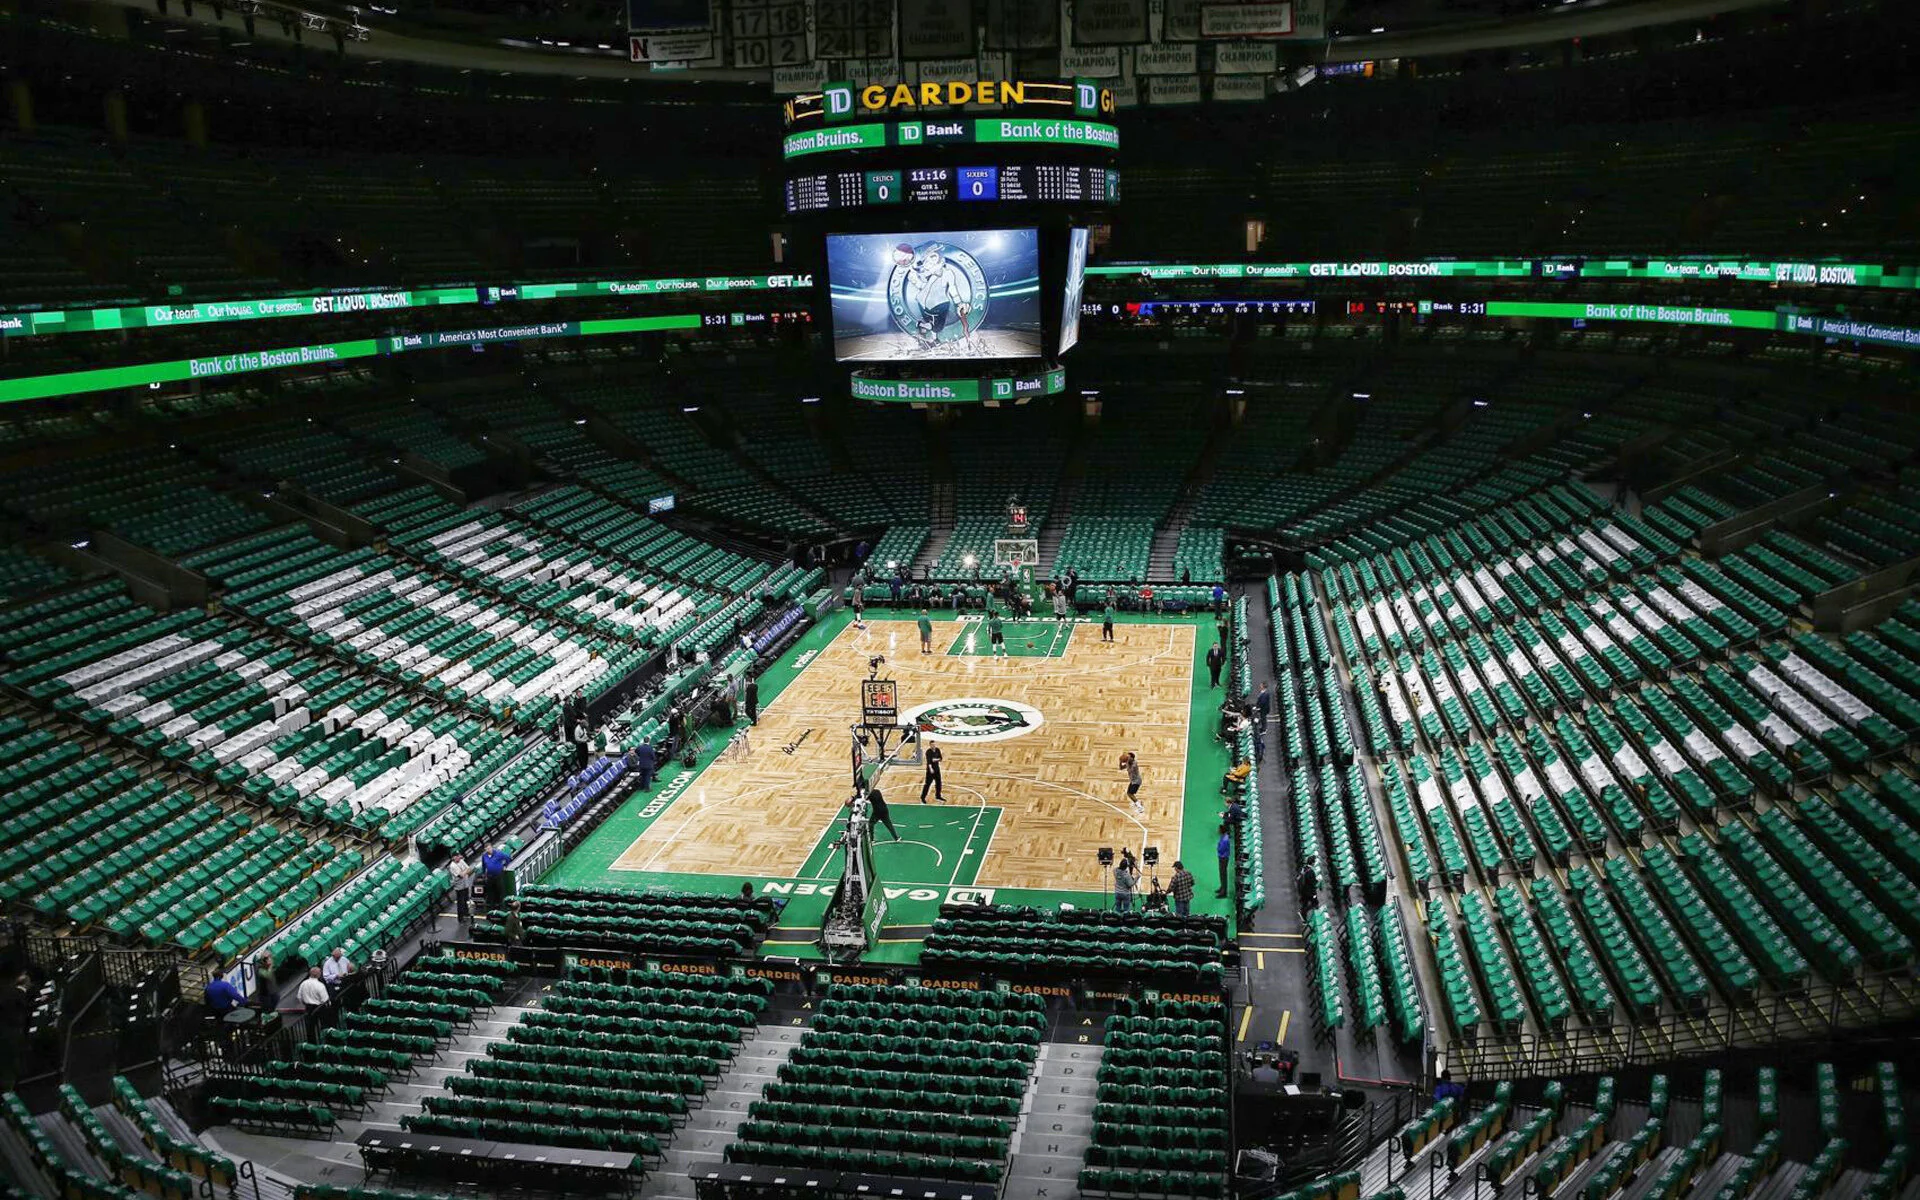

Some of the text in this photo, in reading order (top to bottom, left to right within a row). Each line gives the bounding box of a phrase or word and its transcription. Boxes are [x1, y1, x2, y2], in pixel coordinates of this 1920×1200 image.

[736, 11, 763, 34] 17
[776, 10, 800, 33] 18
[632, 38, 648, 59] N
[737, 43, 765, 65] 10
[780, 39, 796, 62] 2
[1065, 56, 1116, 67] CHAMPIONS
[1141, 53, 1192, 65] CHAMPIONS
[1220, 51, 1273, 62] CHAMPIONS
[826, 81, 1024, 113] TD GARDEN
[1077, 84, 1096, 109] TD
[901, 124, 964, 140] TD Bank
[1000, 122, 1042, 138] Bank
[1045, 122, 1060, 138] of
[1063, 124, 1082, 139] the
[816, 130, 863, 148] Bruins.
[912, 170, 947, 181] 11:16
[878, 185, 888, 200] 0
[972, 180, 984, 196] 0
[1159, 267, 1186, 275] team.
[1211, 266, 1241, 275] house.
[1310, 264, 1337, 276] GET
[1389, 264, 1441, 276] BOSTON.
[1665, 264, 1678, 273] Our
[1680, 264, 1700, 274] team.
[1705, 264, 1718, 275] Our
[1776, 264, 1790, 281] GET
[610, 276, 793, 292] Our team. Our house. Our season. GET
[892, 252, 986, 327] BOSTON CELTICS
[501, 288, 517, 296] Bank
[155, 309, 172, 321] Our
[176, 308, 200, 320] team.
[208, 304, 224, 317] Our
[261, 303, 274, 313] Our
[313, 299, 334, 313] GET
[371, 293, 408, 307] BOSTON.
[1112, 305, 1119, 314] 0
[1460, 303, 1484, 313] 5:31
[705, 315, 726, 325] 5:31
[1586, 306, 1732, 324] Bank of the Boston Bruins.
[404, 335, 422, 346] Bank
[439, 330, 476, 343] America's
[478, 328, 497, 340] Most
[499, 325, 539, 339] Convenient
[1798, 317, 1813, 328] Bank
[1822, 320, 1850, 334] America's
[1851, 323, 1866, 335] Most
[1867, 325, 1904, 340] Convenient
[191, 346, 337, 376] Bank of the Boston Bruins.
[859, 383, 898, 397] Boston
[899, 383, 956, 398] Bruins.
[995, 379, 1041, 395] TD Bank
[638, 770, 697, 819] CELTICS.COM
[456, 950, 506, 961] GARDEN
[580, 957, 631, 970] GARDEN
[662, 960, 715, 975] GARDEN
[747, 967, 800, 982] GARDEN
[833, 975, 889, 986] GARDEN
[922, 979, 979, 990] GARDEN
[1012, 983, 1071, 997] GARDEN
[1162, 993, 1220, 1002] GARDEN
[1052, 1124, 1062, 1132] G
[1048, 1144, 1058, 1152] H
[1043, 1166, 1052, 1174] J
[1037, 1188, 1048, 1196] K
